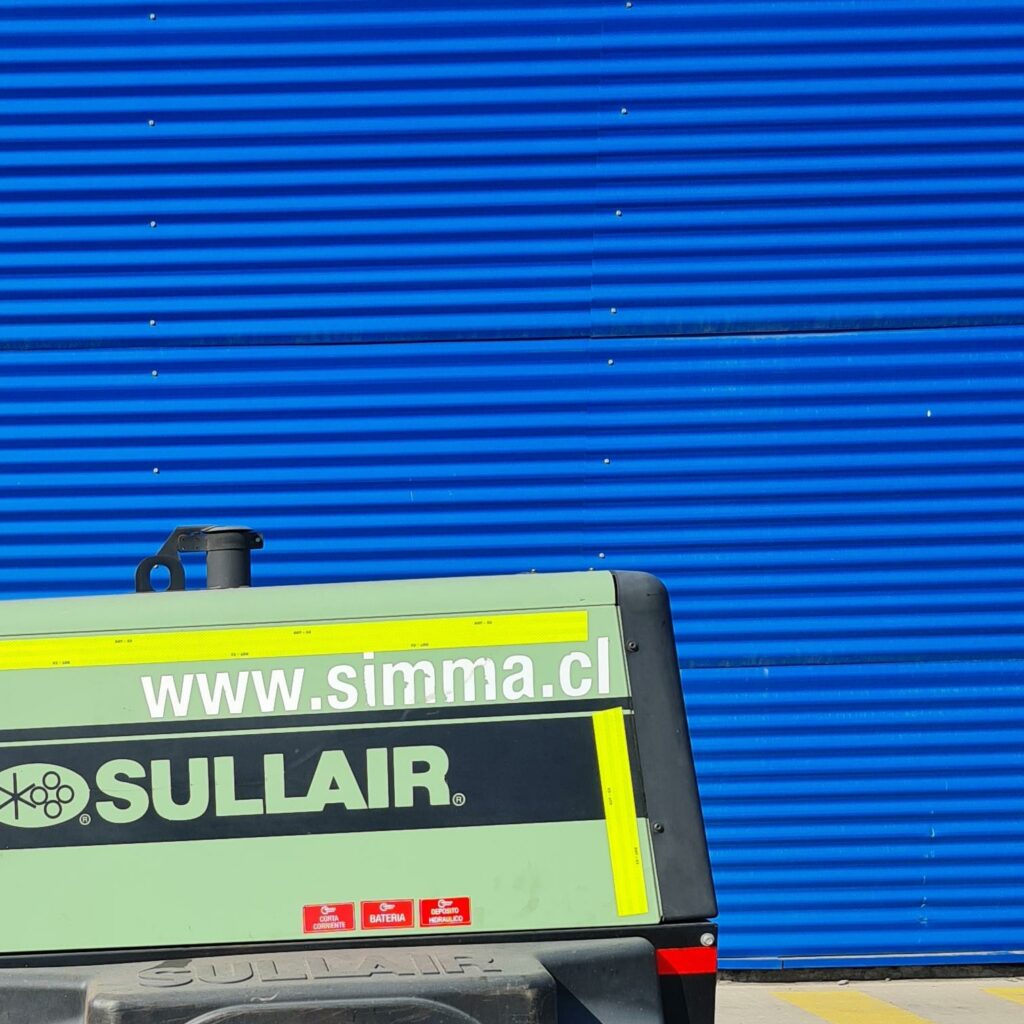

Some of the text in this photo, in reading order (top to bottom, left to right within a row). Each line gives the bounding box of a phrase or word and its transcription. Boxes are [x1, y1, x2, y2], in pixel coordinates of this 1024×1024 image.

[140, 636, 611, 718] www.simma.cl
[95, 745, 451, 824] SULLAIR
[369, 913, 406, 923] BATERIA
[137, 955, 503, 988] SULLAIR
